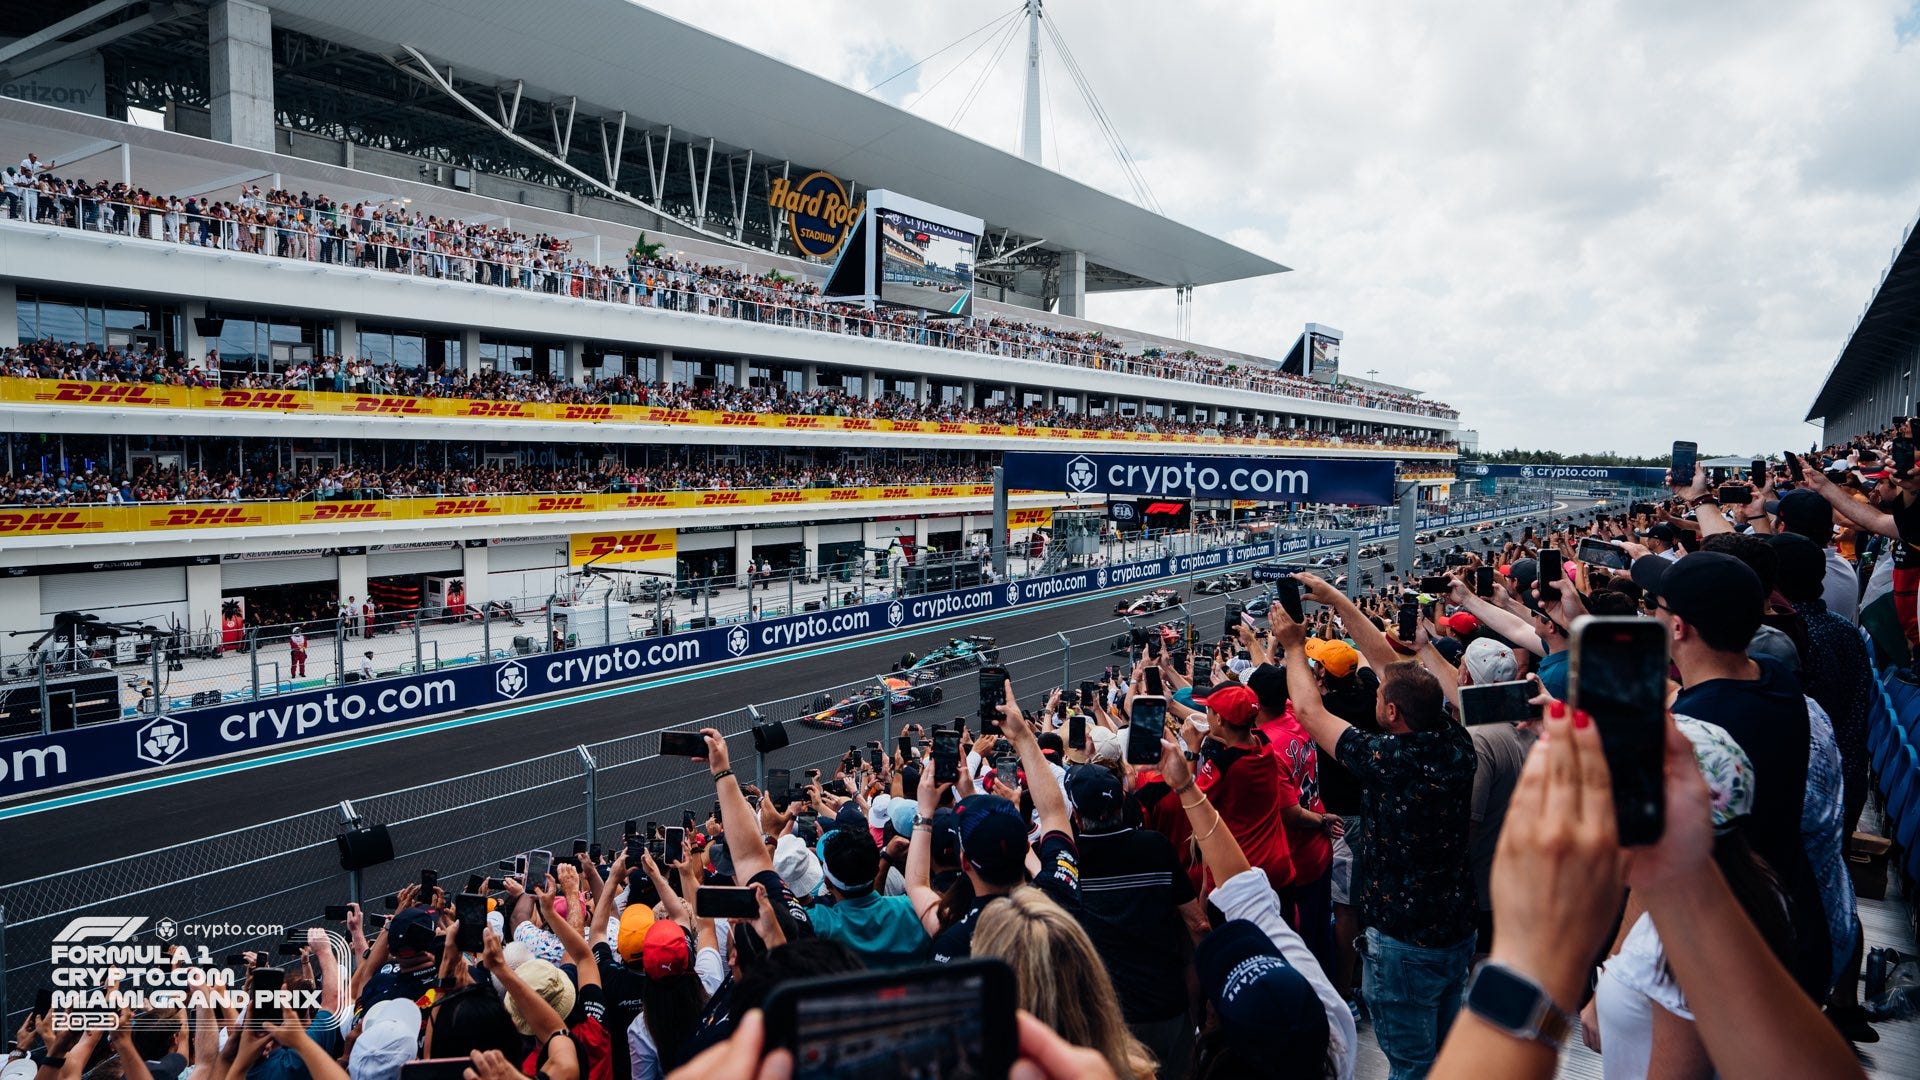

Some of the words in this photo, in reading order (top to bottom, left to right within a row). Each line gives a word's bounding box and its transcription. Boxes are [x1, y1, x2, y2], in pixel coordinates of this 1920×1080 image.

[769, 178, 825, 214] Hard
[800, 226, 835, 244] STADIUM
[54, 383, 154, 404] DHL
[219, 391, 304, 409] DHL
[355, 397, 422, 415] DHL
[467, 402, 526, 418] DHL
[565, 406, 615, 420] DHL
[649, 409, 692, 423] DHL
[721, 413, 760, 427] DHL
[784, 416, 819, 429] DHL
[842, 419, 873, 431] DHL
[892, 421, 920, 433] DHL
[1107, 461, 1309, 494] crypto.com
[1537, 466, 1608, 478] crypto.com
[702, 493, 740, 506] DHL
[770, 491, 803, 503] DHL
[829, 489, 861, 501] DHL
[883, 488, 909, 499] DHL
[931, 487, 955, 497] DHL
[433, 500, 490, 515] DHL
[537, 497, 586, 512] DHL
[626, 495, 669, 508] DHL
[166, 507, 251, 526] DHL
[313, 504, 381, 520] DHL
[1014, 509, 1046, 525] DHL
[1114, 505, 1132, 517] FIA
[0, 512, 86, 532] DHL
[588, 533, 662, 557] DHL
[1236, 543, 1270, 561] crypto.com
[1180, 551, 1221, 574] crypto.com
[1111, 560, 1161, 583] crypto.com
[1025, 574, 1087, 598] crypto.com
[912, 589, 993, 620] crypto.com
[762, 608, 870, 646] crypto.com
[547, 637, 700, 684] crypto.com
[219, 678, 456, 743] crypto.com
